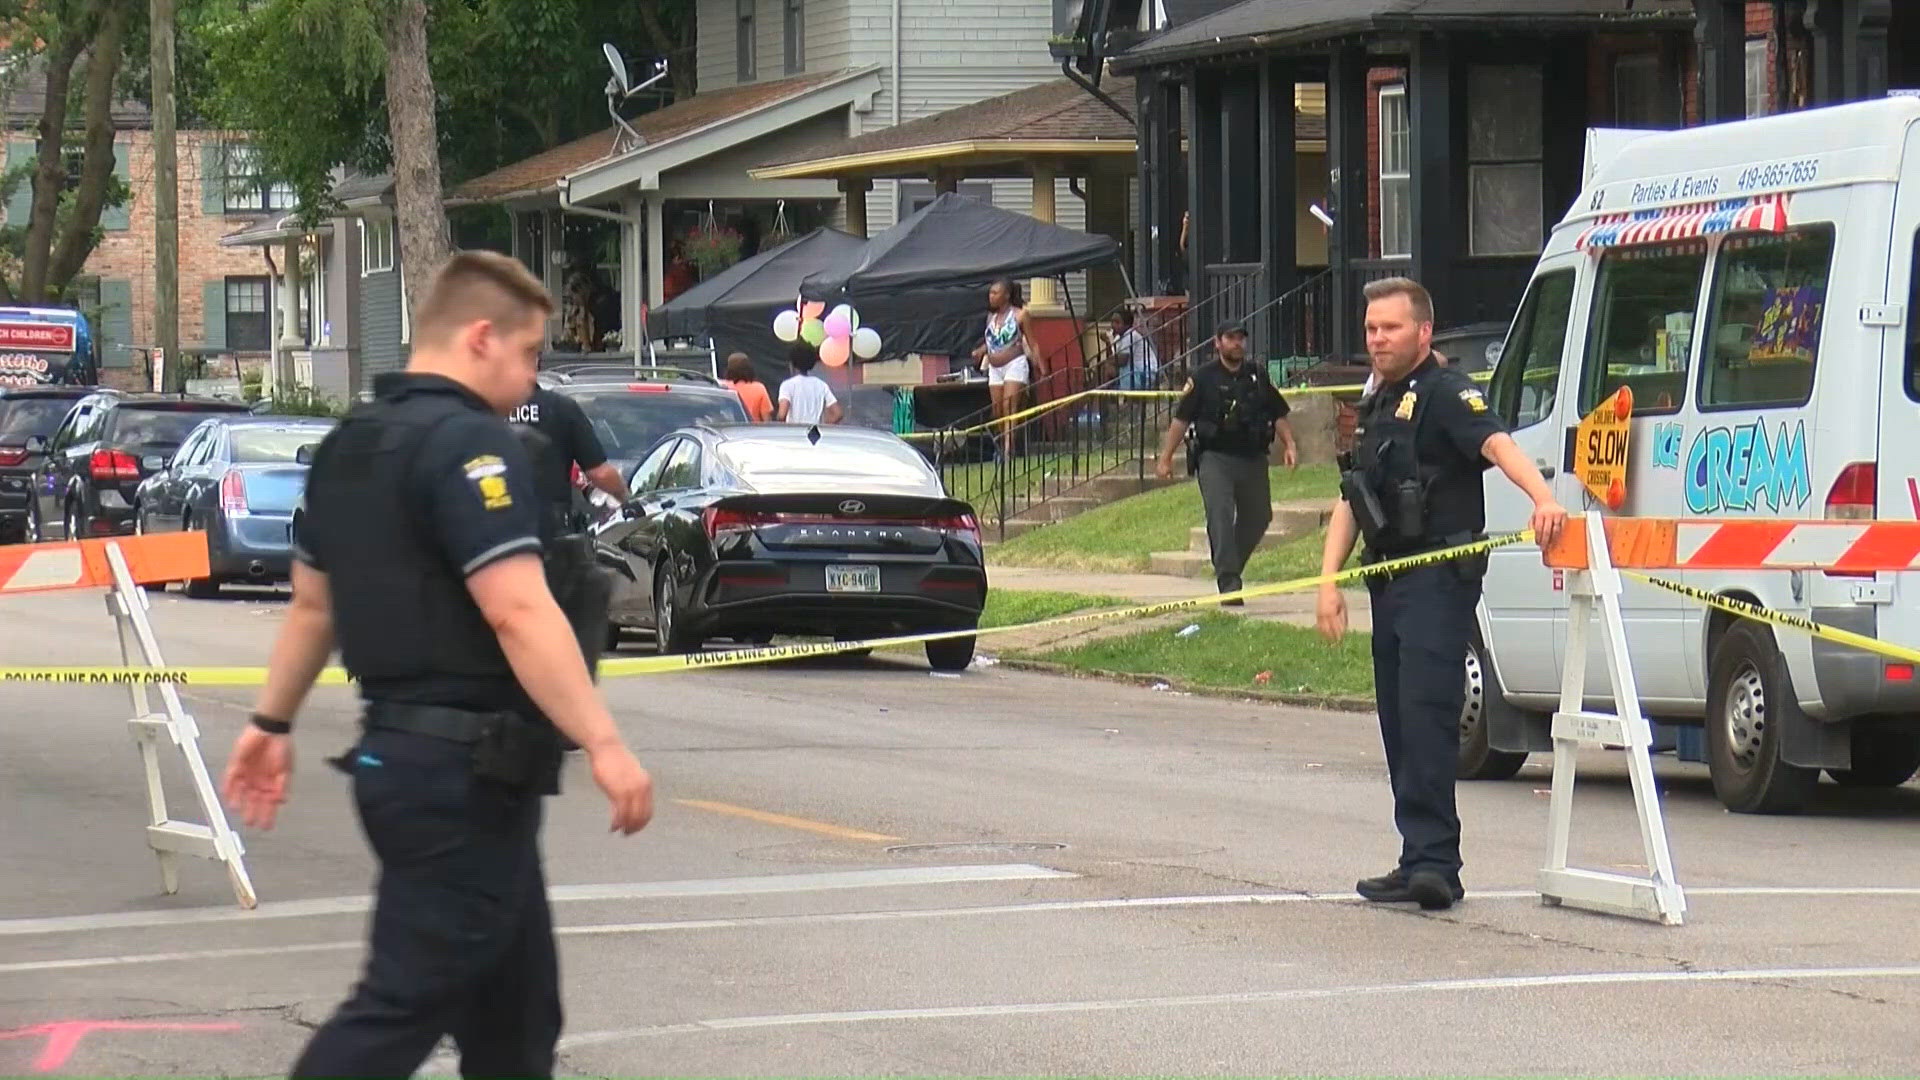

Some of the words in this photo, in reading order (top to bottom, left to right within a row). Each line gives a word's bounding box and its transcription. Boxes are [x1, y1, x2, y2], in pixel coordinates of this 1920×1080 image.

[1738, 159, 1819, 190] 419-865-7655
[1591, 190, 1605, 210] 82
[1631, 181, 1667, 204] Parties
[1670, 177, 1679, 199] &
[1682, 175, 1719, 197] Events
[509, 404, 540, 422] LICE
[1587, 429, 1628, 466] SLOW
[1653, 421, 1684, 469] ICE
[1685, 415, 1812, 514] CREAM
[800, 528, 903, 538] ELANTRA
[686, 651, 733, 666] POLICE
[736, 648, 766, 661] LINE
